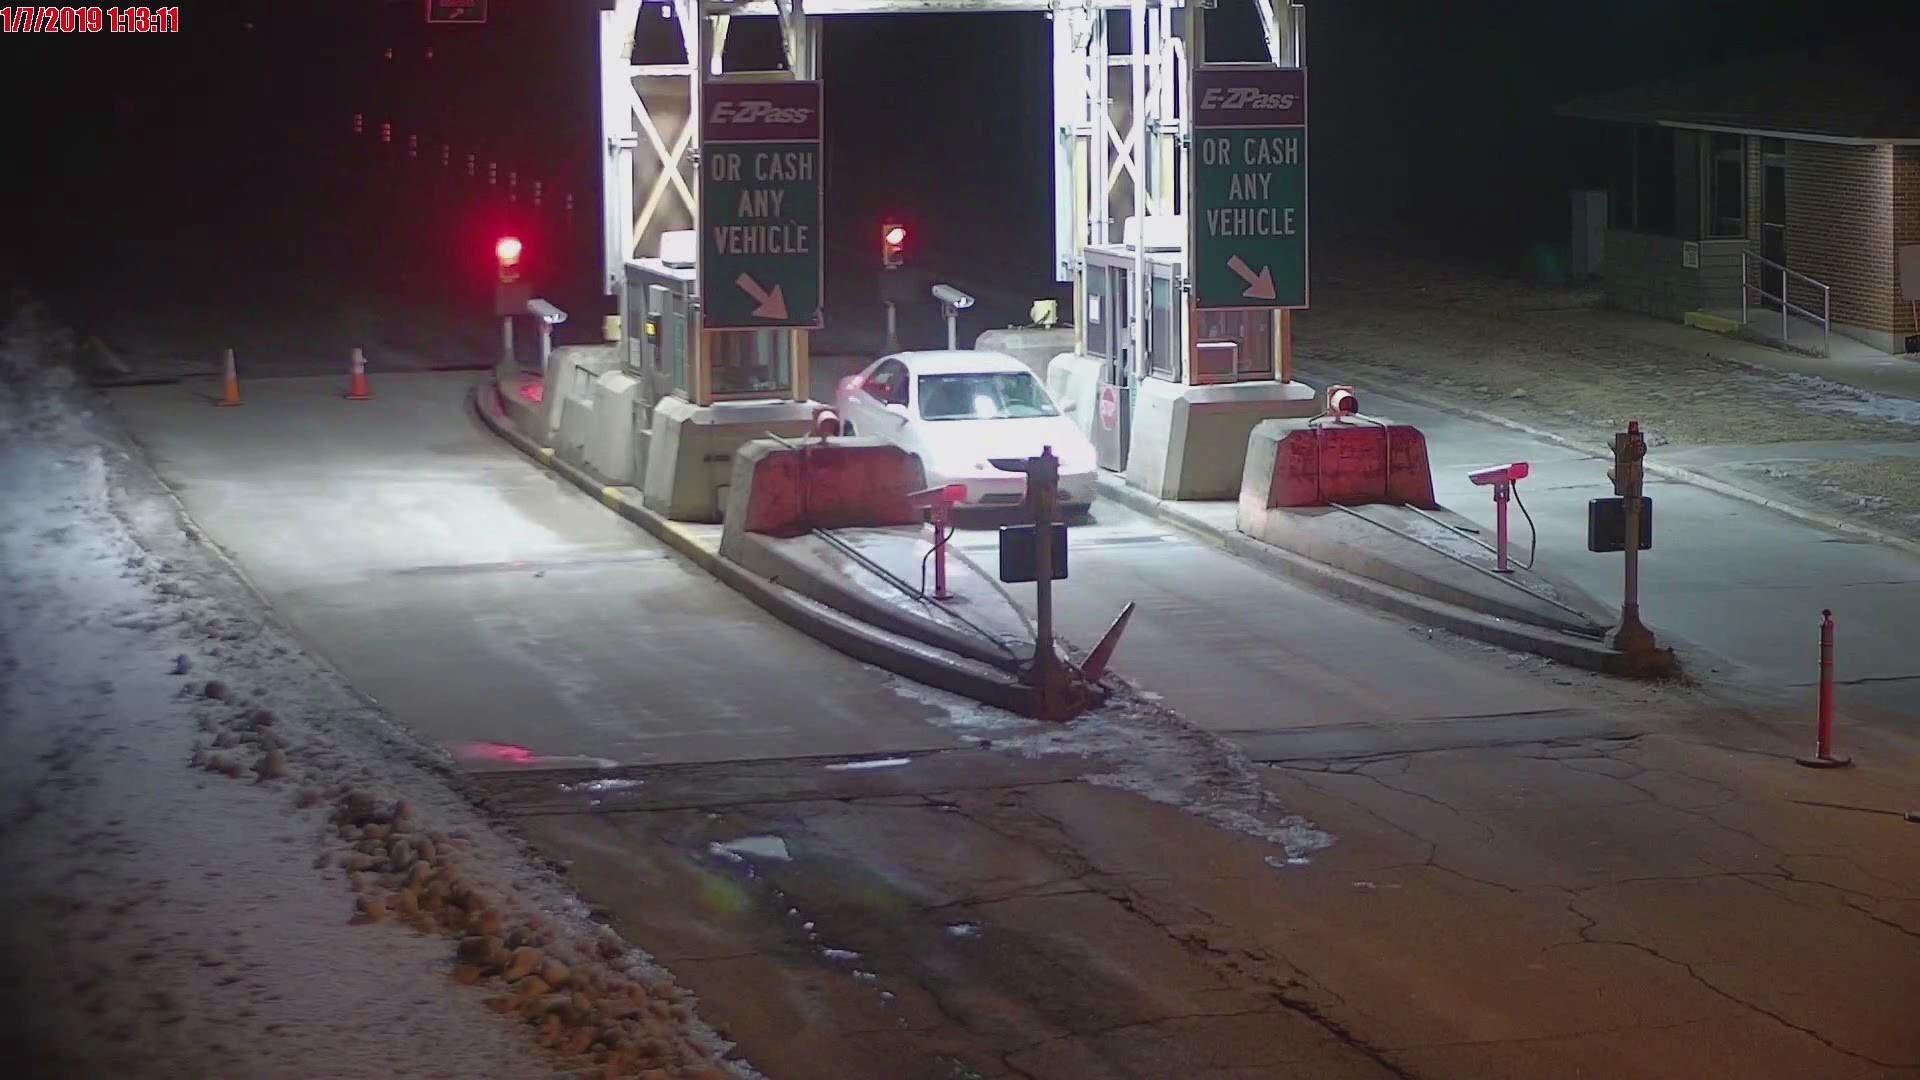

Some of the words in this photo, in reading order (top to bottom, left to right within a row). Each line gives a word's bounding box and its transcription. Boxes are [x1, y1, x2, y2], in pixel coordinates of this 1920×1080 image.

[710, 101, 813, 121] E-ZPass
[1200, 88, 1297, 109] E-ZPass
[1203, 138, 1229, 165] OR
[1245, 138, 1297, 165] CASH
[712, 153, 740, 181] OR
[755, 152, 813, 180] CASH
[1229, 173, 1272, 200] ANY
[738, 190, 784, 217] ANY
[1207, 208, 1295, 236] VEHICLE
[714, 226, 808, 254] VEHICLE
